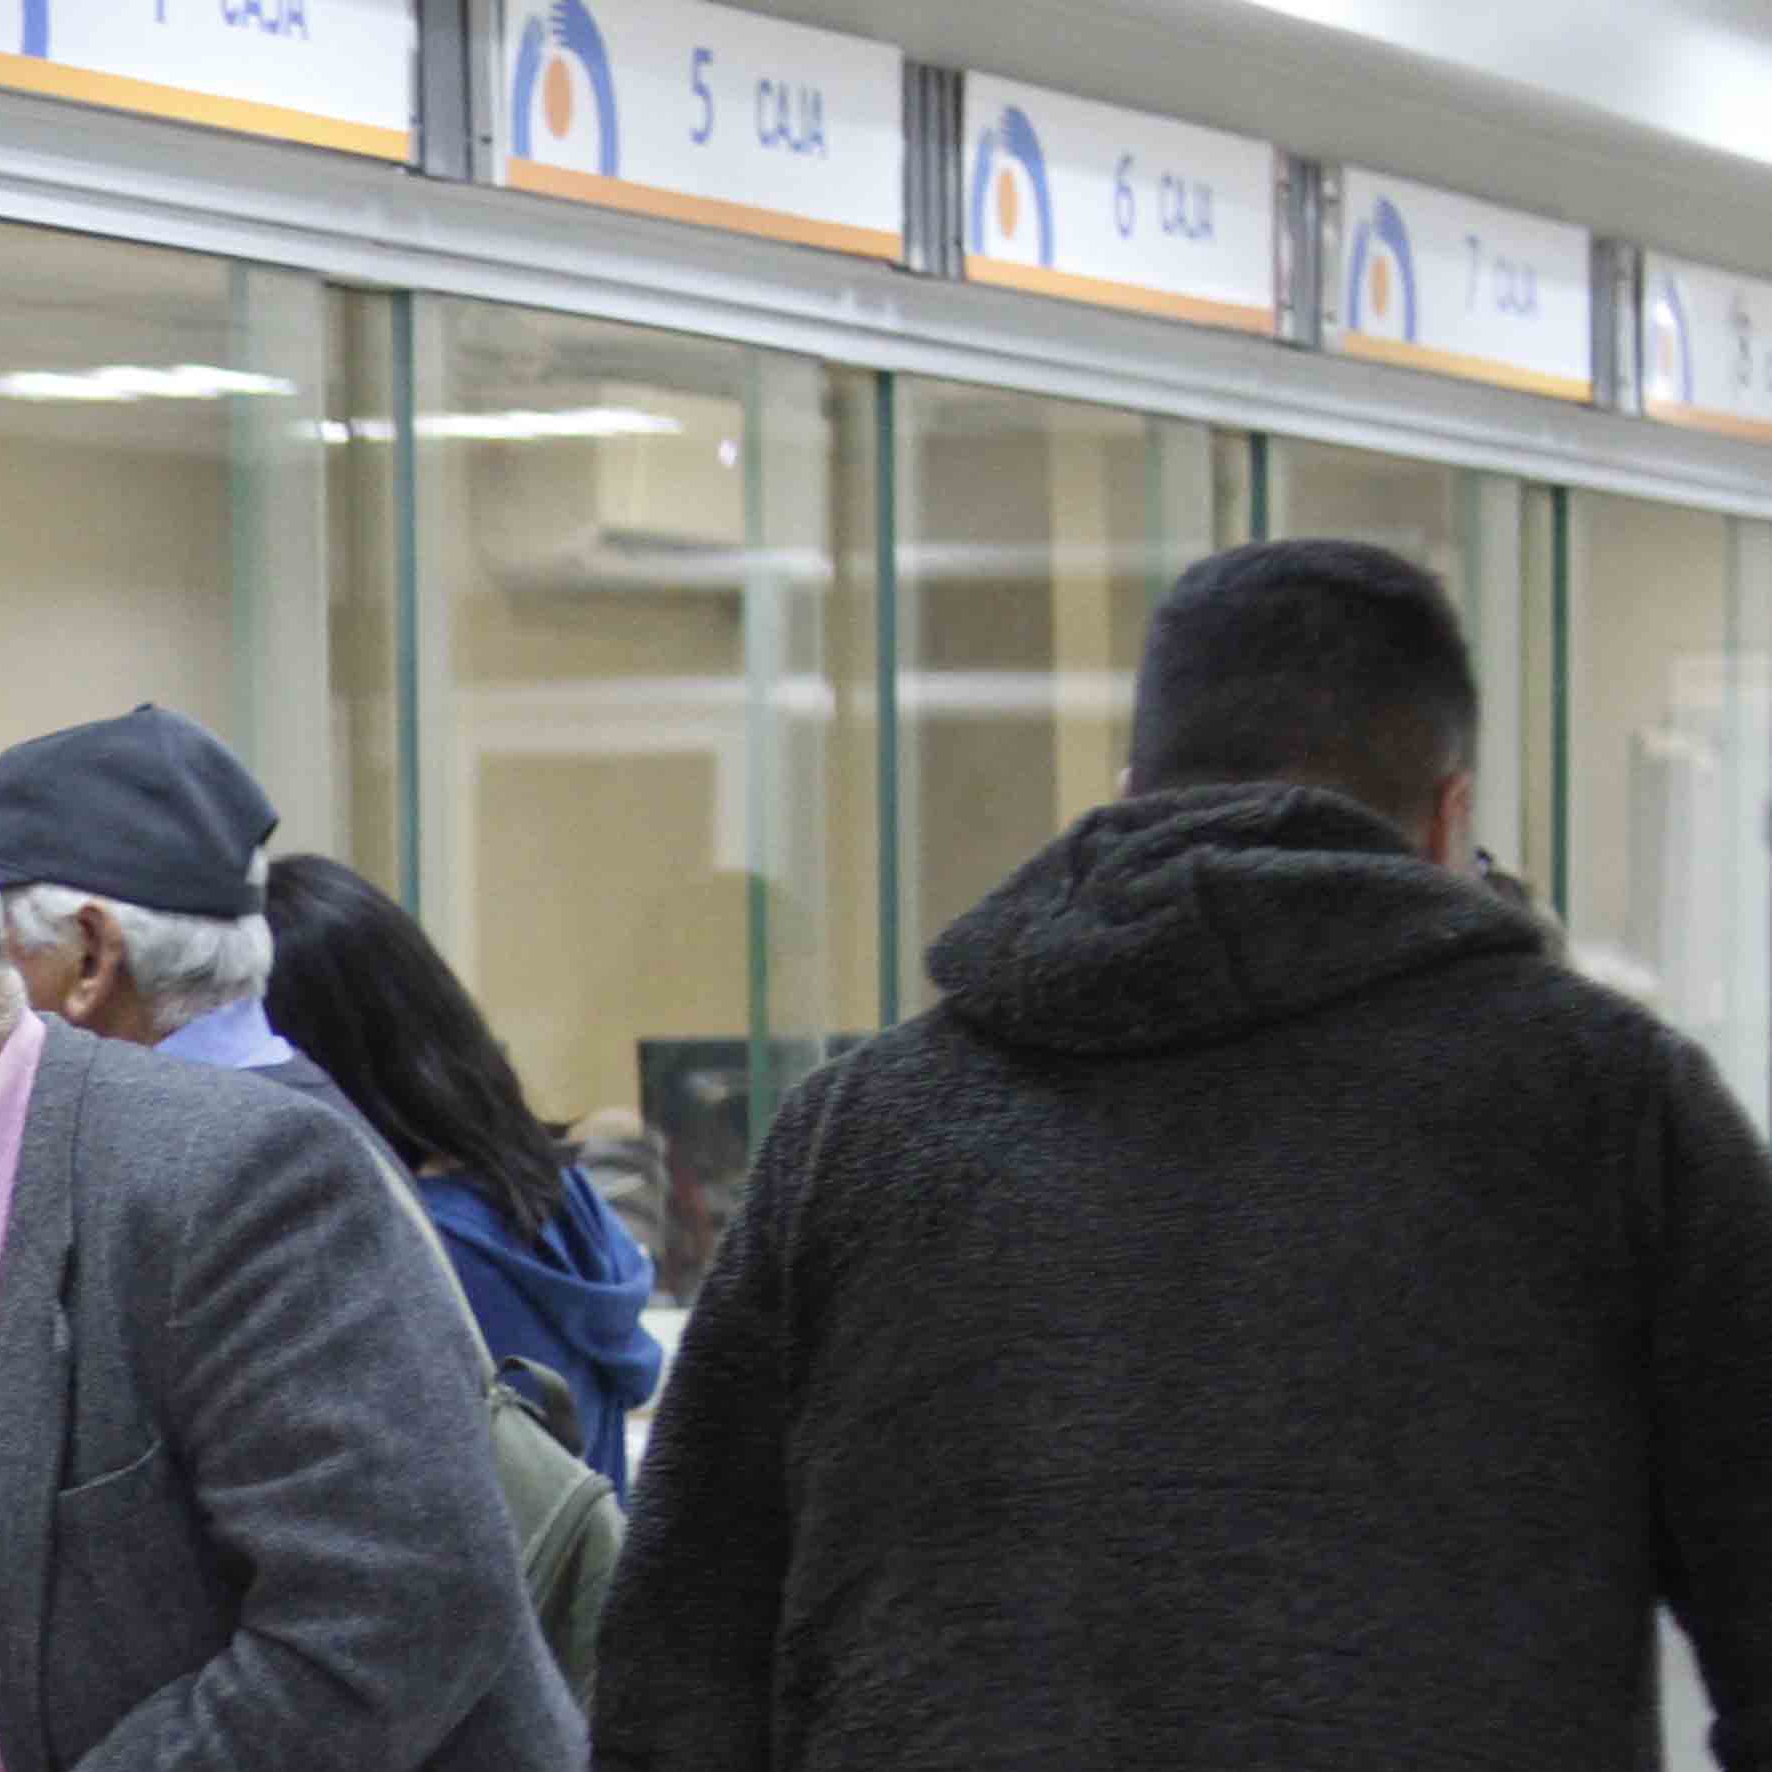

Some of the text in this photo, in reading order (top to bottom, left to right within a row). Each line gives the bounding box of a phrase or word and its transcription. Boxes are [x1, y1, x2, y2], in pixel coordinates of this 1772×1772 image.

[689, 47, 827, 157] 5 CAJA
[1114, 153, 1216, 245] 6 CAJA
